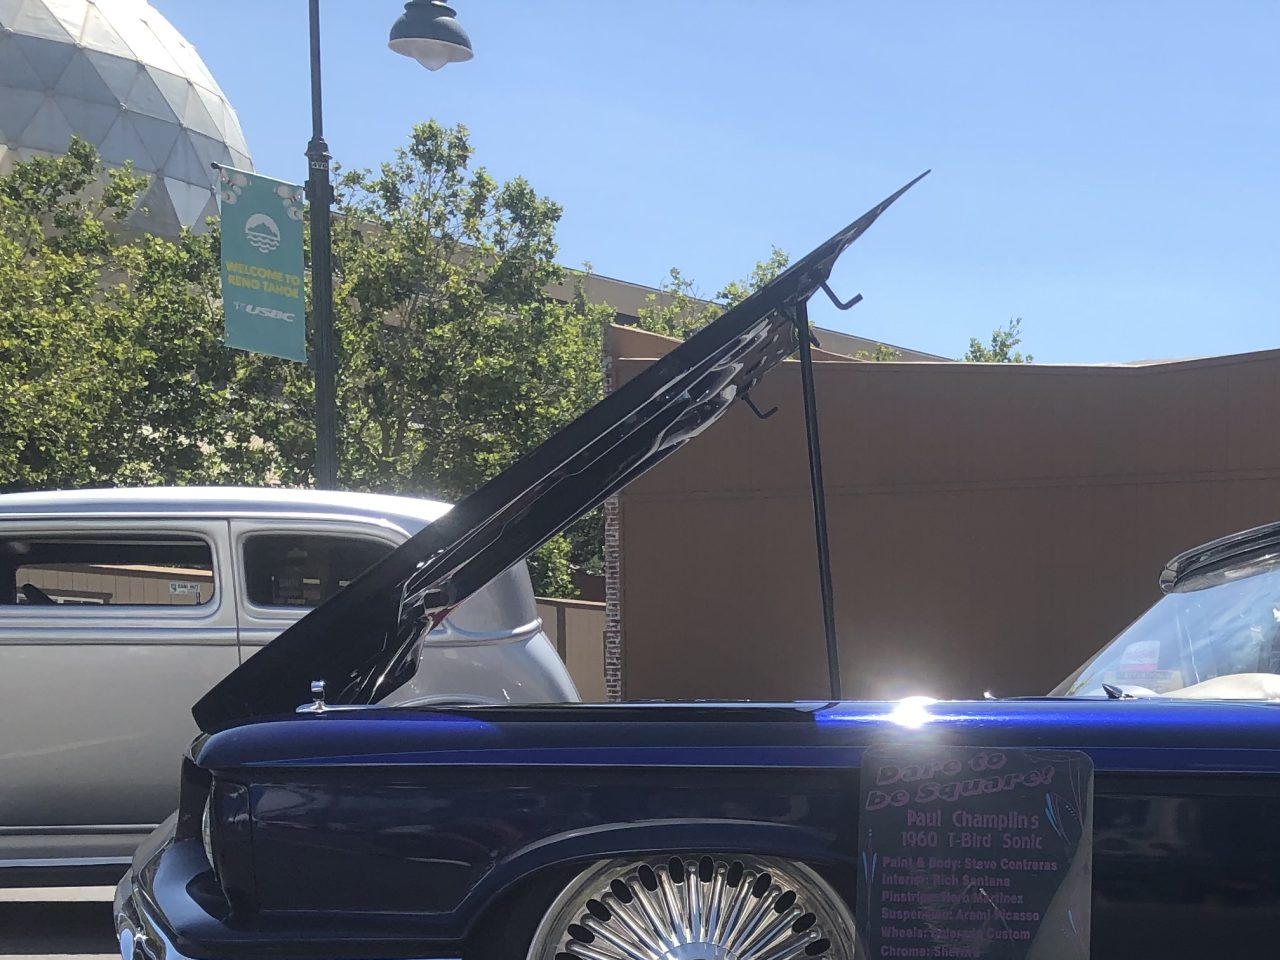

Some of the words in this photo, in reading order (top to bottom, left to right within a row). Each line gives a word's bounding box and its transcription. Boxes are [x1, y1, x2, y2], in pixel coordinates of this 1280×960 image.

[225, 261, 284, 281] WELCOME
[284, 274, 301, 286] TO
[246, 304, 295, 322] USBC
[907, 809, 942, 827] Paul
[902, 831, 938, 848] 1960
[948, 832, 992, 848] T-Bird
[1003, 833, 1042, 850] Sonic
[882, 857, 914, 869] Paint
[929, 857, 961, 871] Body:
[1000, 858, 1058, 871] Contreras
[881, 926, 928, 938] Wheels:
[987, 928, 1031, 940] Custom
[881, 945, 931, 957] Chrome:
